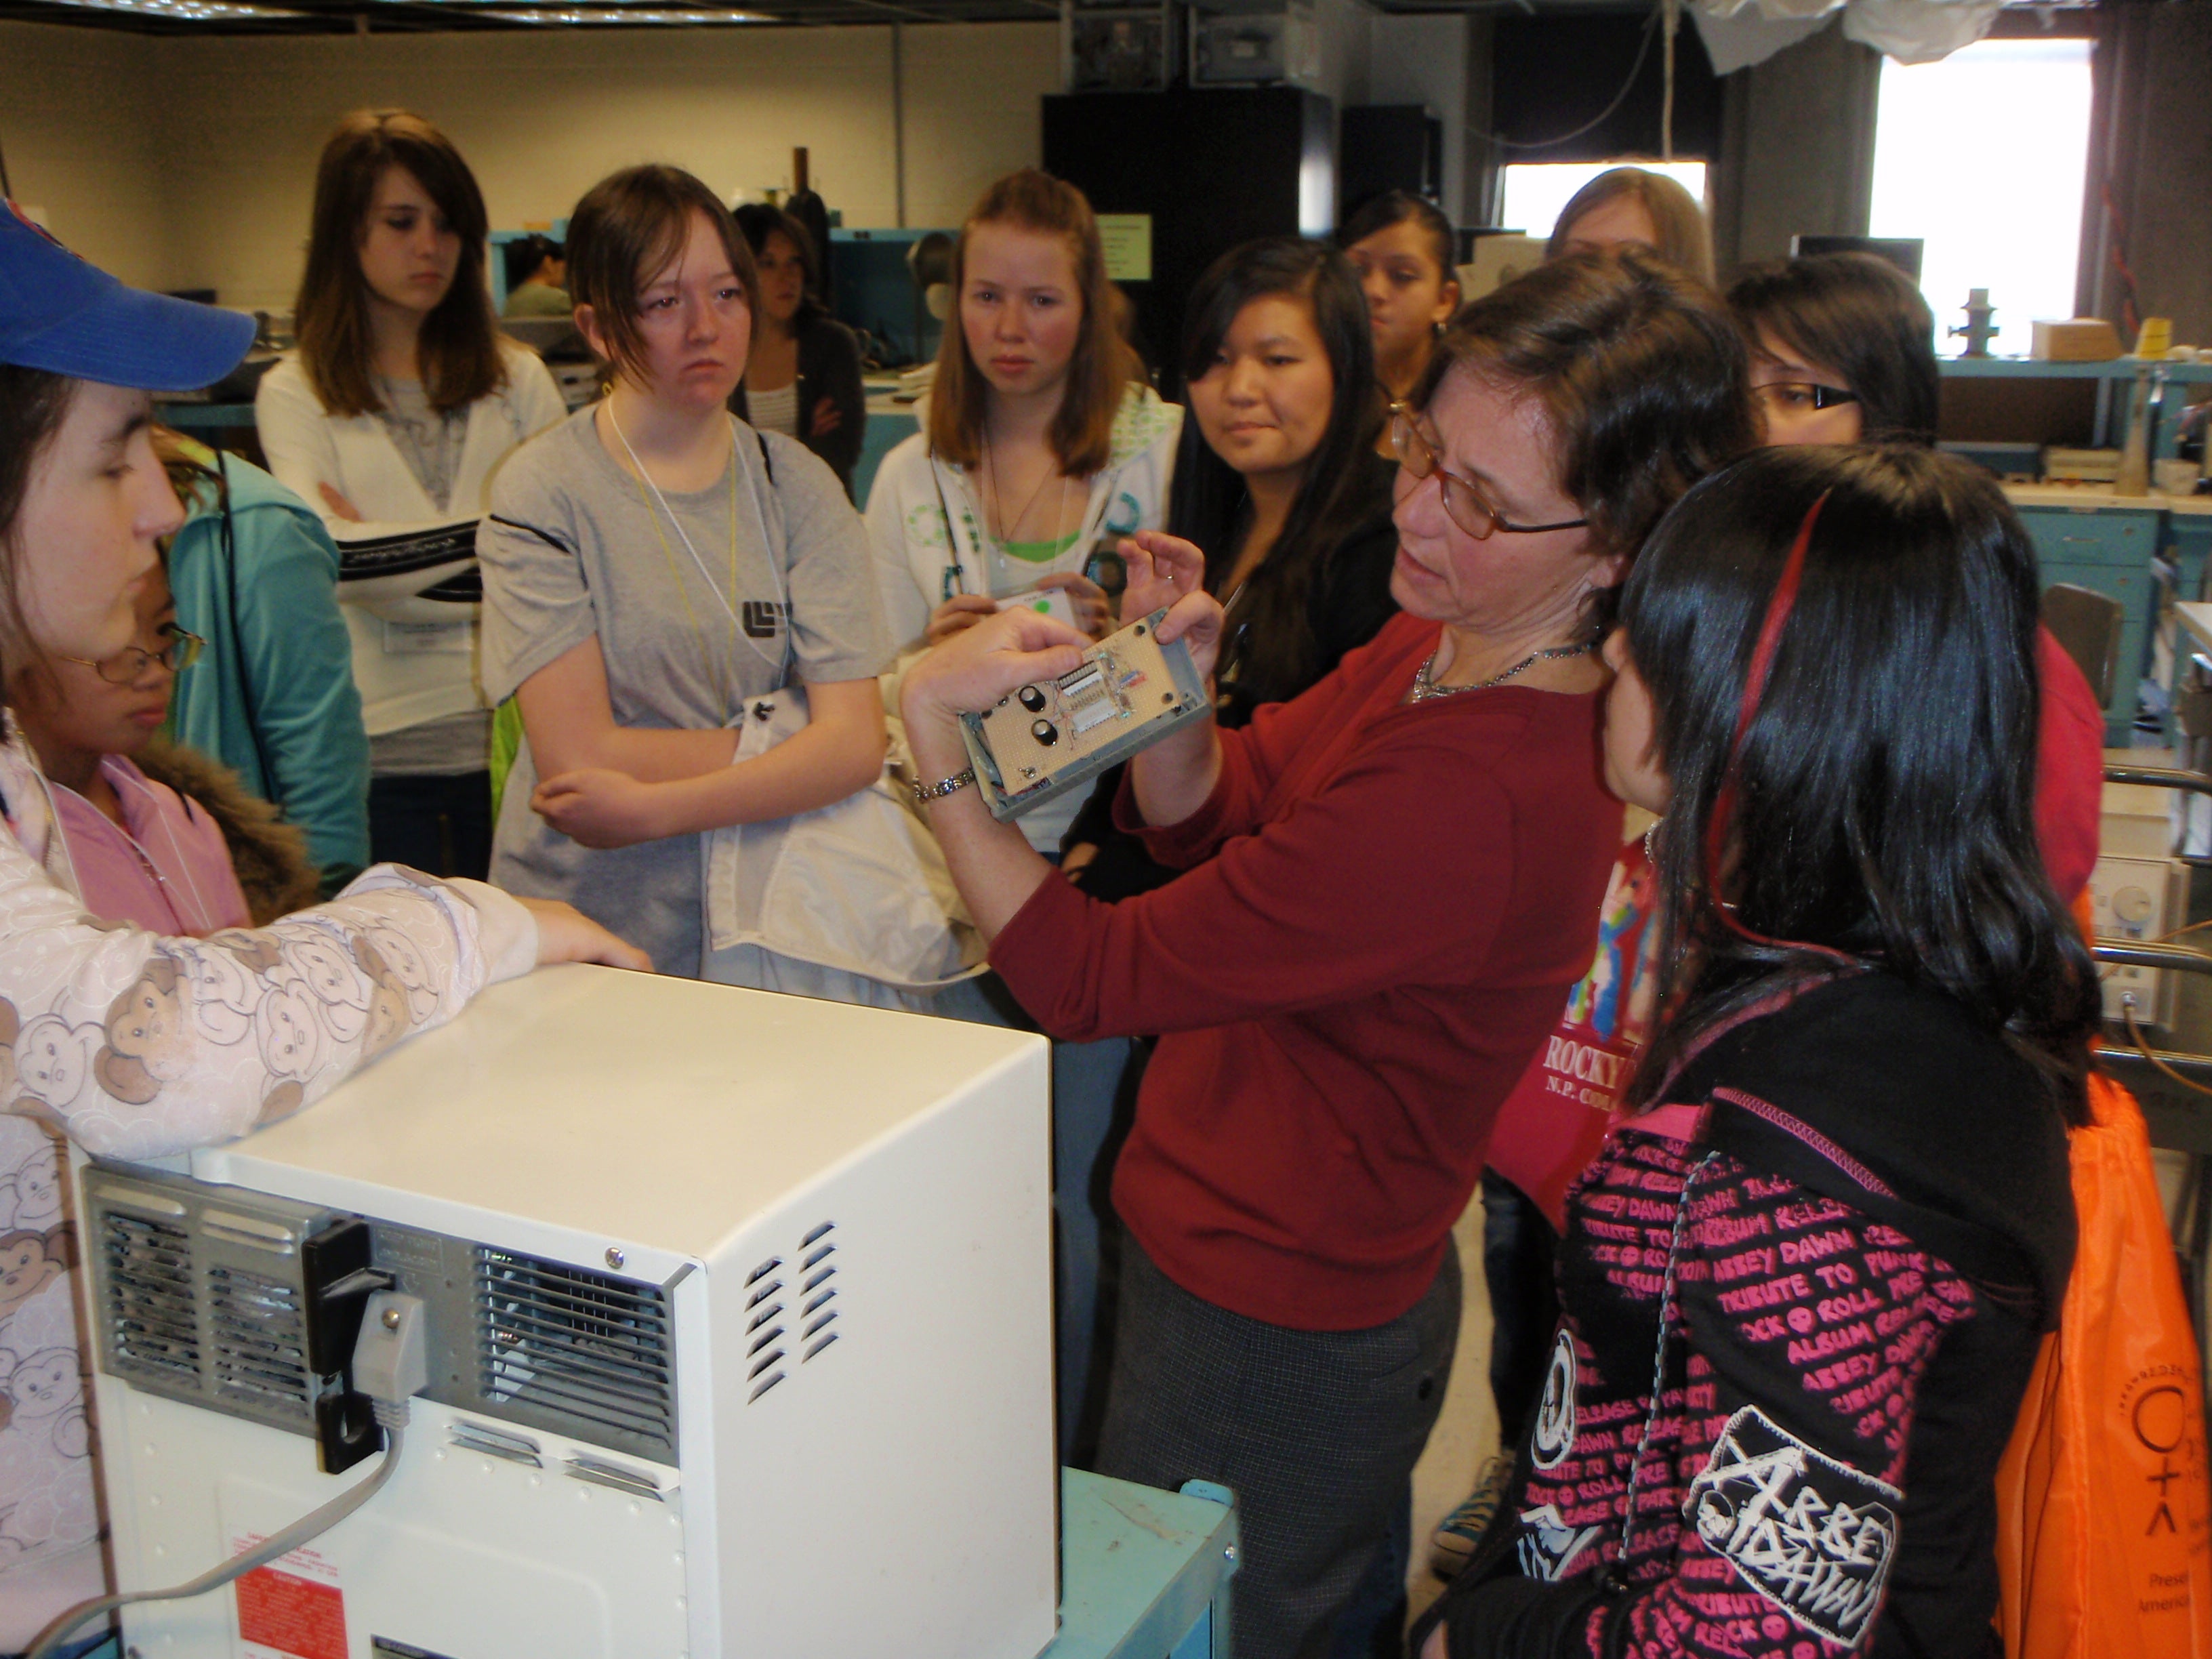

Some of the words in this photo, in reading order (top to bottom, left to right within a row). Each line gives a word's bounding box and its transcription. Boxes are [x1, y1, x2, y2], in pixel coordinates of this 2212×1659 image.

[1546, 1076, 1575, 1099] N.P.
[1780, 1228, 1858, 1265] DAWN
[1717, 1273, 1815, 1313] TRIBUTE
[1815, 1263, 1858, 1290] TO
[1816, 1289, 1885, 1322] ROLL
[1787, 1321, 1877, 1365] ALBUM
[1803, 1353, 1879, 1391] ABBEY
[1577, 1475, 1627, 1499] ROLL
